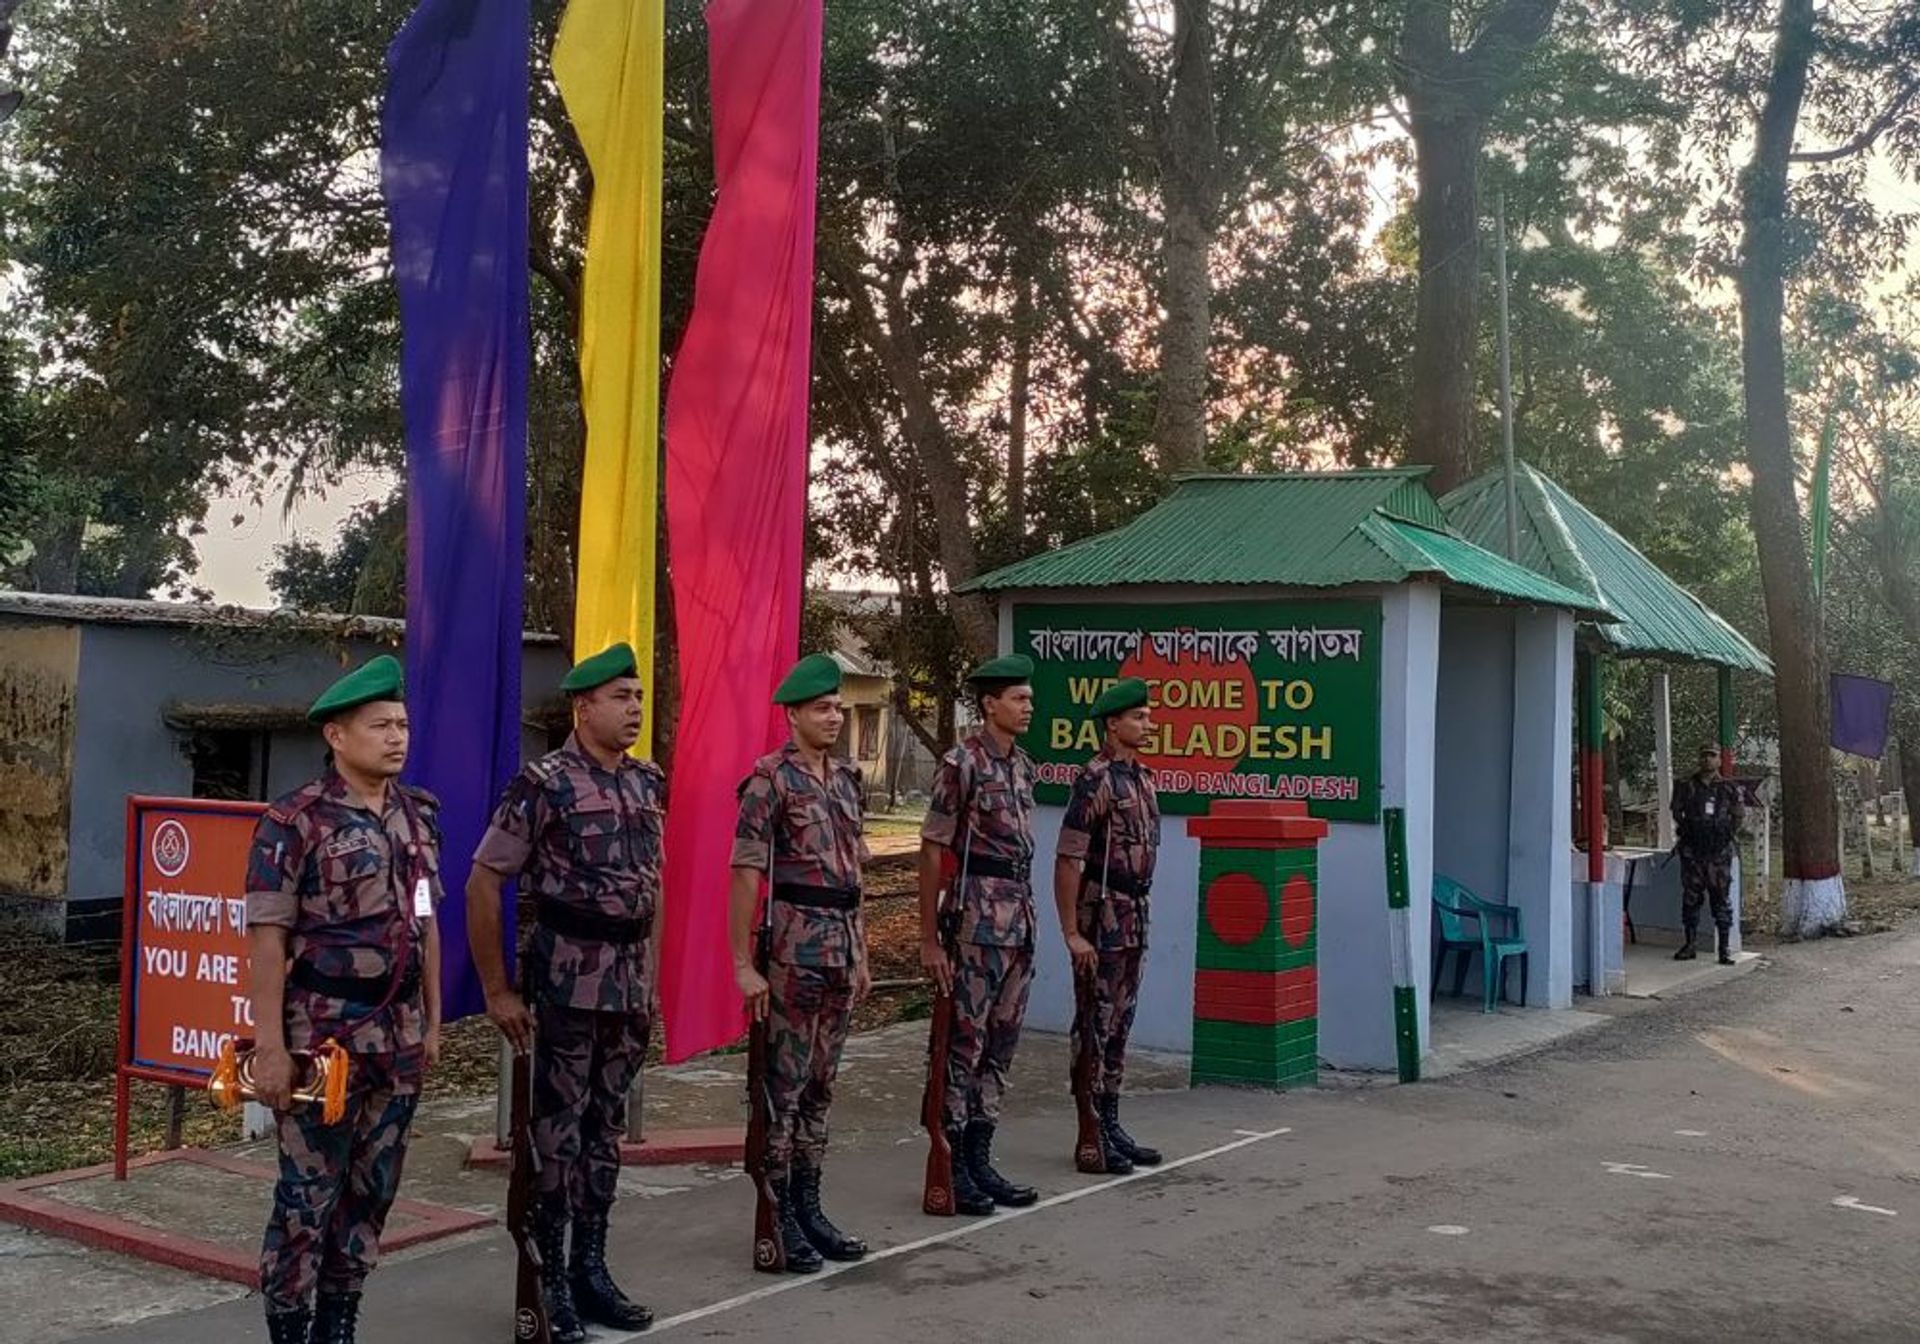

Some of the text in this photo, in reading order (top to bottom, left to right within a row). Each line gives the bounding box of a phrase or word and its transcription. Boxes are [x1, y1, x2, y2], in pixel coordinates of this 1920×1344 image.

[1029, 624, 1362, 664] বাংলাদেশে আপনাকে স্বাগতম
[1067, 677, 1314, 710] WCOME TO
[1050, 717, 1332, 760] BAGLADESH
[1195, 771, 1359, 800] BANGLADESH
[146, 887, 223, 935] বাংলাদেশে
[143, 946, 239, 985] YOU ARE
